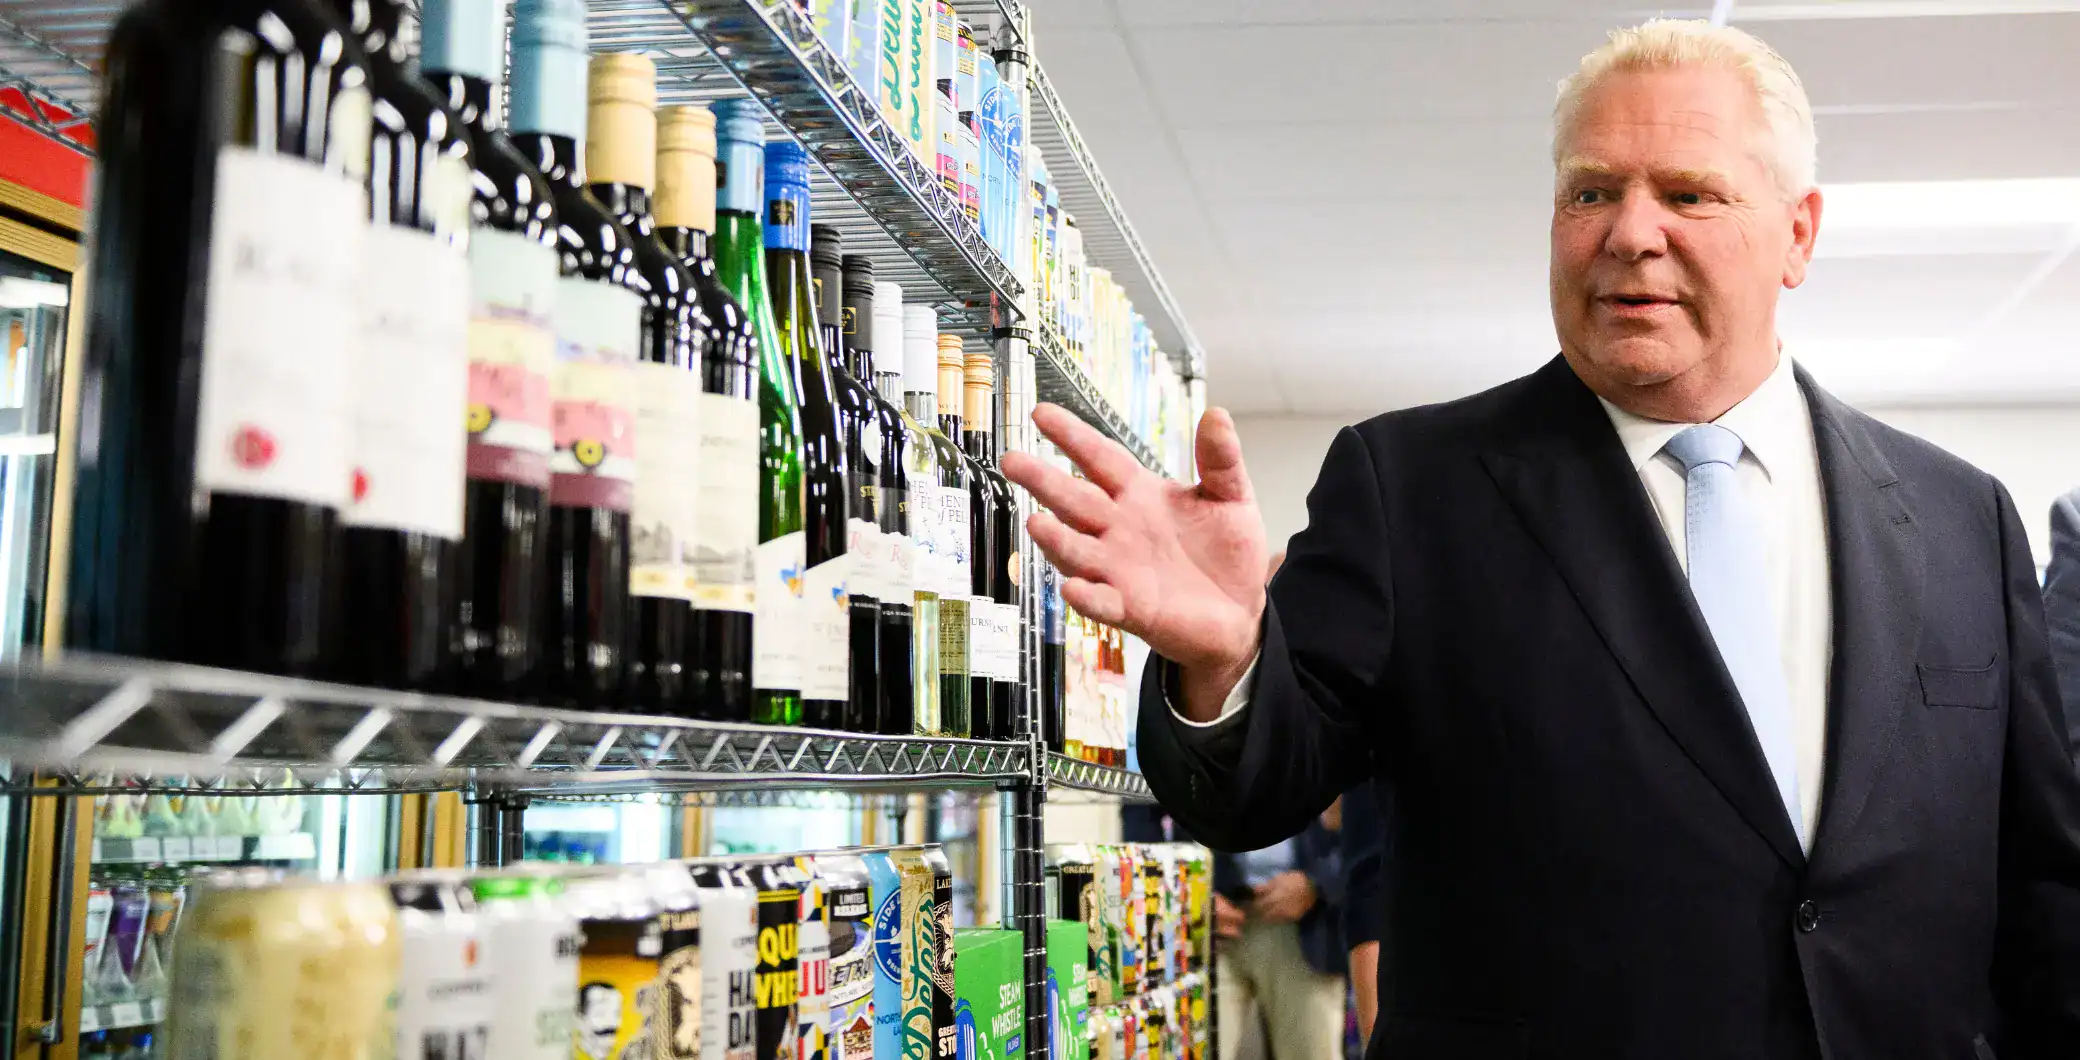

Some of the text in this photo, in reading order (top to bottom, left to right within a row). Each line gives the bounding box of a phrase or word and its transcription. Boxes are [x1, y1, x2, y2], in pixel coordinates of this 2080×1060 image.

[879, 900, 896, 930] SIDE
[1000, 979, 1020, 1010] STEAM
[992, 1004, 1021, 1040] WHISTLE
